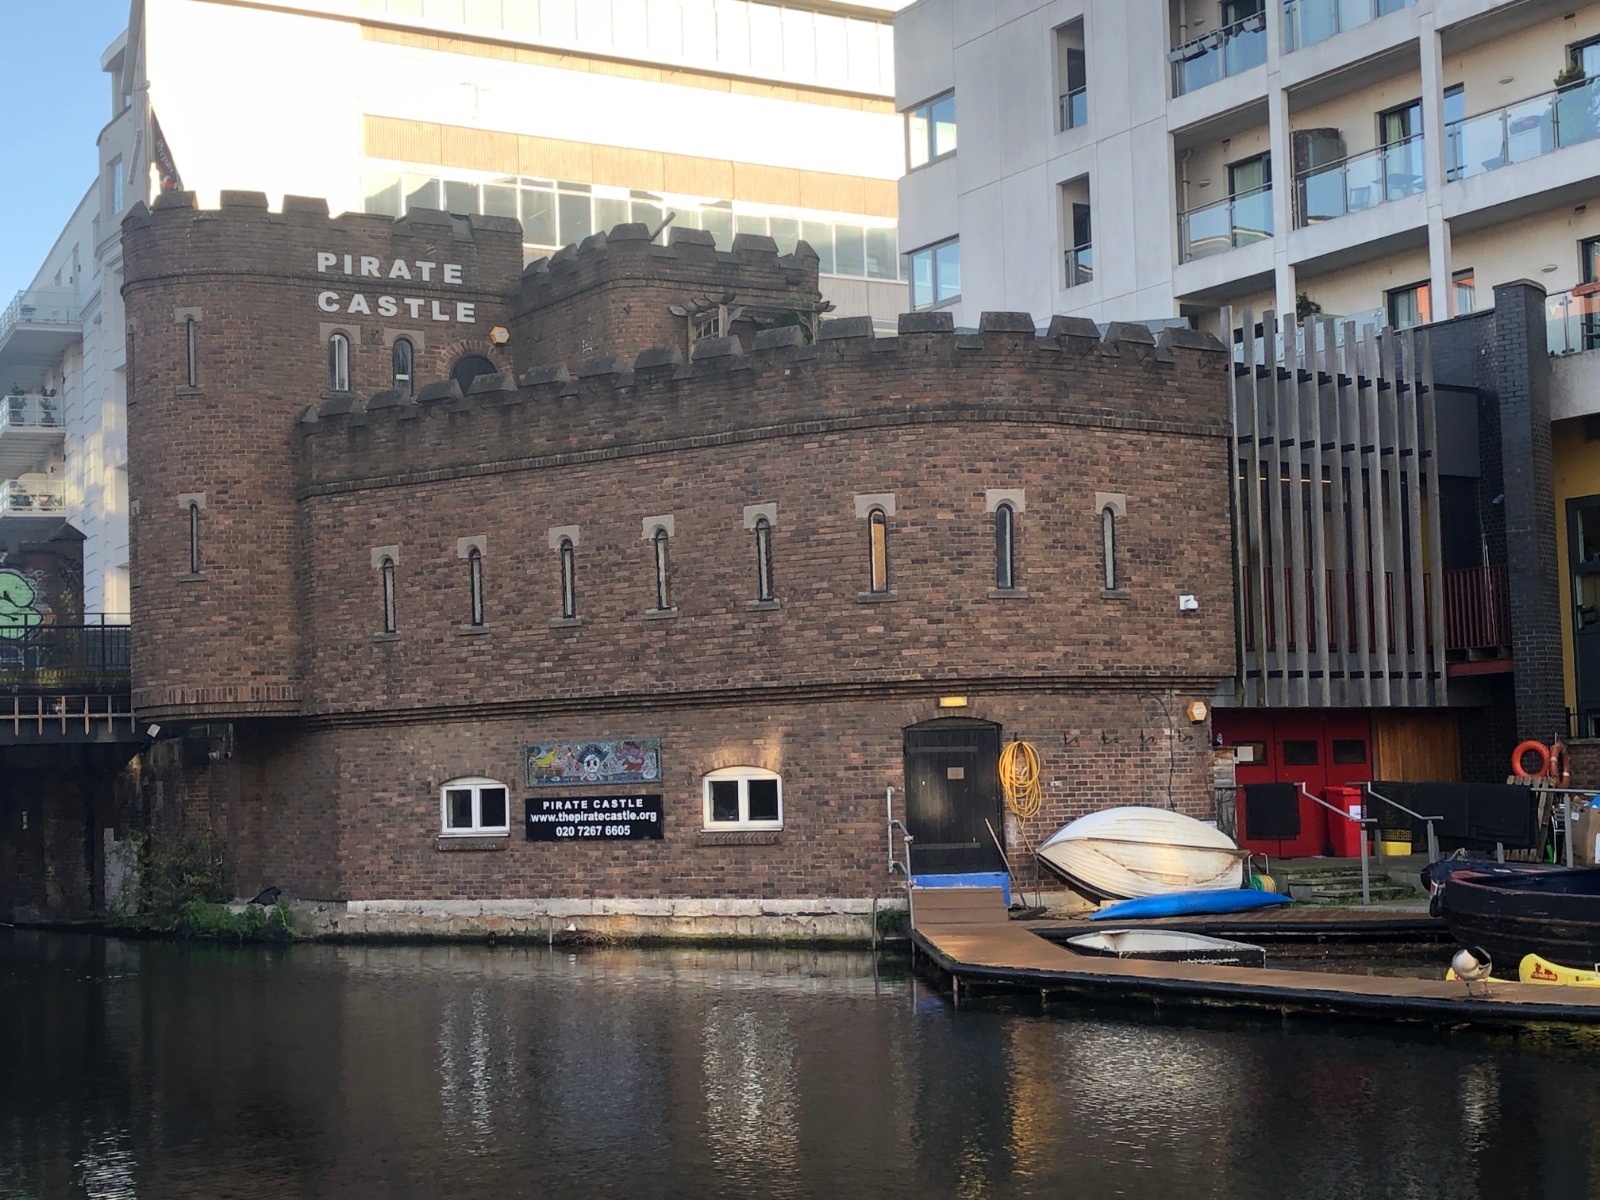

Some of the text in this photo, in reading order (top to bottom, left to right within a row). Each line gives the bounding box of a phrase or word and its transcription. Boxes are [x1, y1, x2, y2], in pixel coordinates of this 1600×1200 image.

[317, 252, 463, 285] PIRATE
[317, 291, 476, 324] CASTLE
[543, 799, 644, 810] PIRATE CASTLE
[530, 810, 657, 824] www.thepiratecastle.org
[556, 825, 631, 837] 020 7267 6605
